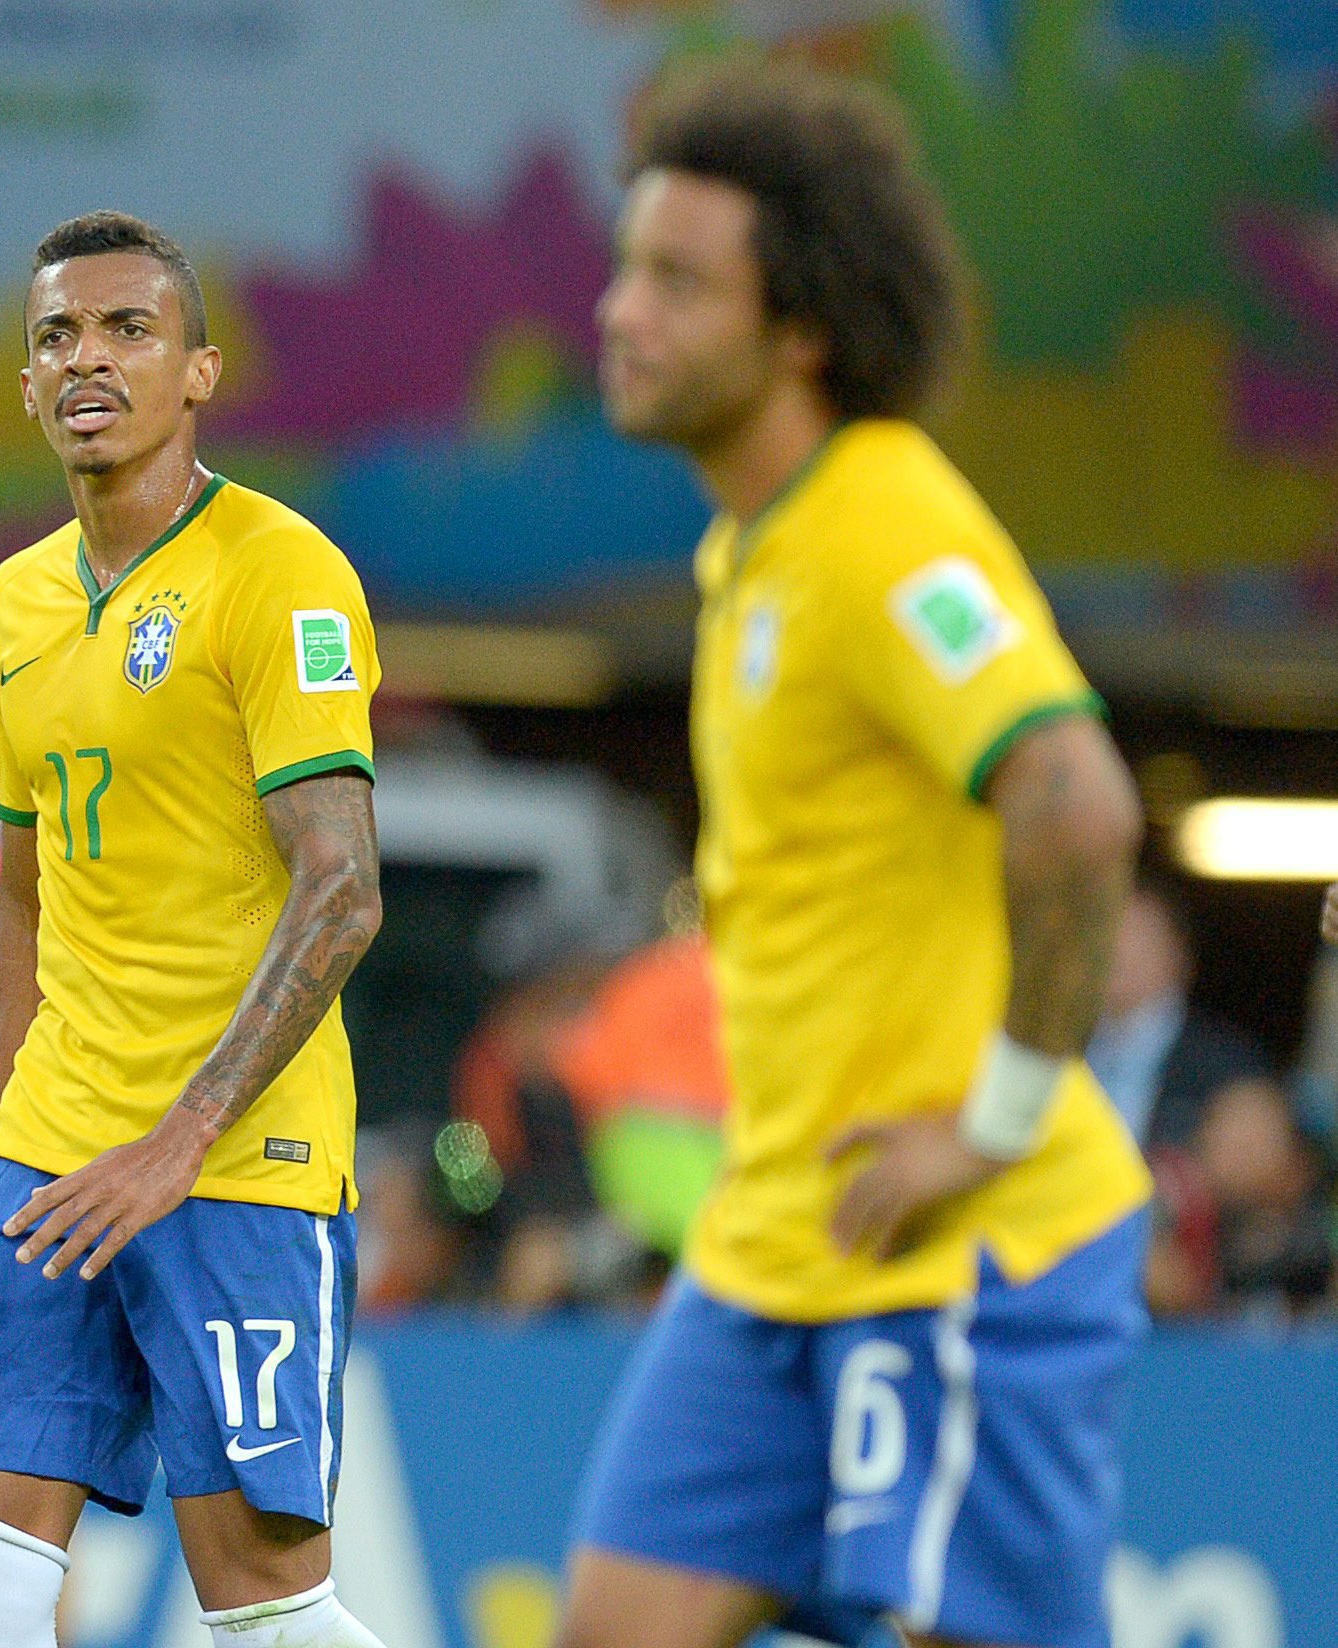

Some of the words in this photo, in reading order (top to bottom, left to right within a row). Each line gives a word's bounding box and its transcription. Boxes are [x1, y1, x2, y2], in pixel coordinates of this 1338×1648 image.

[141, 640, 160, 649] CBF
[45, 747, 112, 861] 17
[205, 1318, 296, 1430] 17
[828, 1338, 913, 1496] 6
